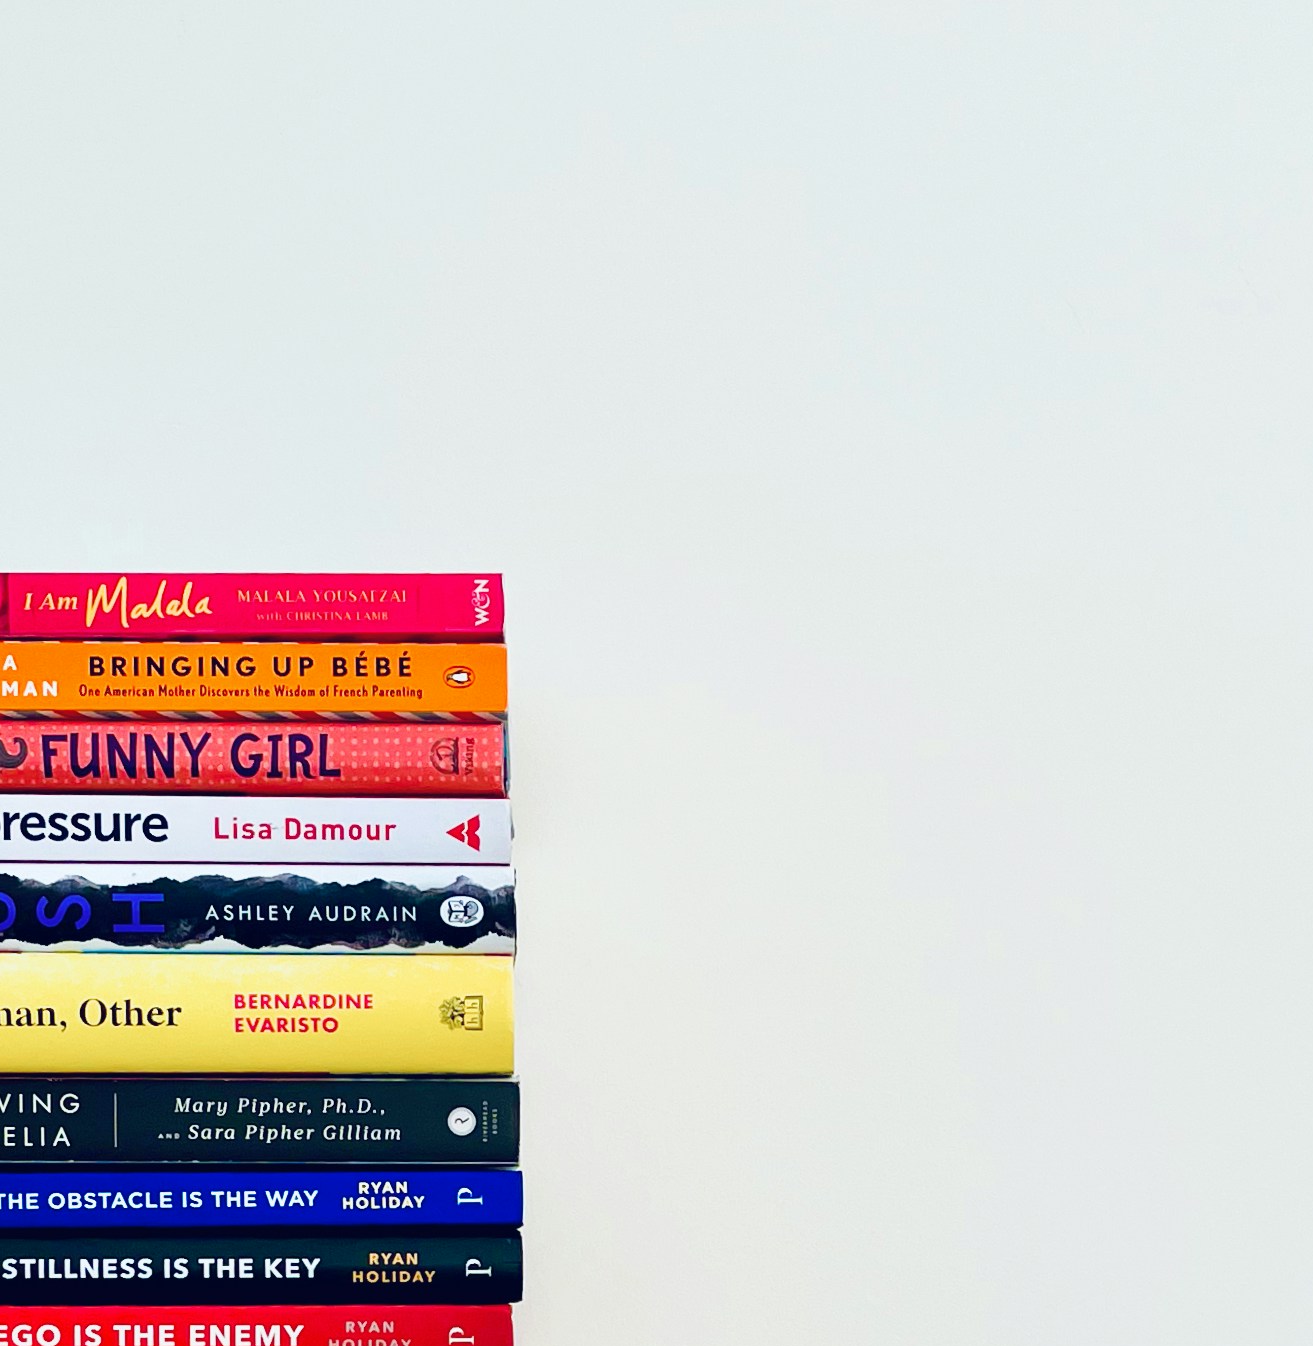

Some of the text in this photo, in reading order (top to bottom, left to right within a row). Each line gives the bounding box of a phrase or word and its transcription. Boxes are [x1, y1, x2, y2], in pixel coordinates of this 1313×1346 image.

[24, 576, 213, 628] I Am Malala
[238, 589, 406, 603] MALALA YOUSAFZAI
[257, 611, 388, 621] with CHRISTINA LAMB
[89, 651, 412, 677] BRINGING UP BÉBÉ
[79, 684, 423, 700] One American Mother Discovers the Wisdom of French Parenting
[41, 732, 341, 779] FUNNY GIRL
[464, 737, 476, 777] Viking
[214, 817, 396, 841] Lisa Damour
[205, 905, 417, 922] ASHLEY AUDRAIN
[234, 994, 373, 1010] BERNARDINE
[79, 998, 182, 1027] Other
[234, 1017, 339, 1033] EVARISTO
[174, 1097, 386, 1116] Mary Pipher, Ph.D.,
[158, 1125, 402, 1144] AND Sara Pipher Gilliam
[358, 1181, 408, 1194] RYAN
[48, 1191, 173, 1210] OBSTACLE
[182, 1191, 203, 1208] IS
[211, 1190, 257, 1208] THE
[265, 1190, 319, 1208] WAY
[342, 1195, 425, 1210] HOLIDAY
[369, 1252, 419, 1266] RYAN
[1, 1257, 321, 1280] STILLNESS IS THE KEY
[352, 1270, 436, 1284] HOLIDAY
[345, 1321, 395, 1334] RYAN
